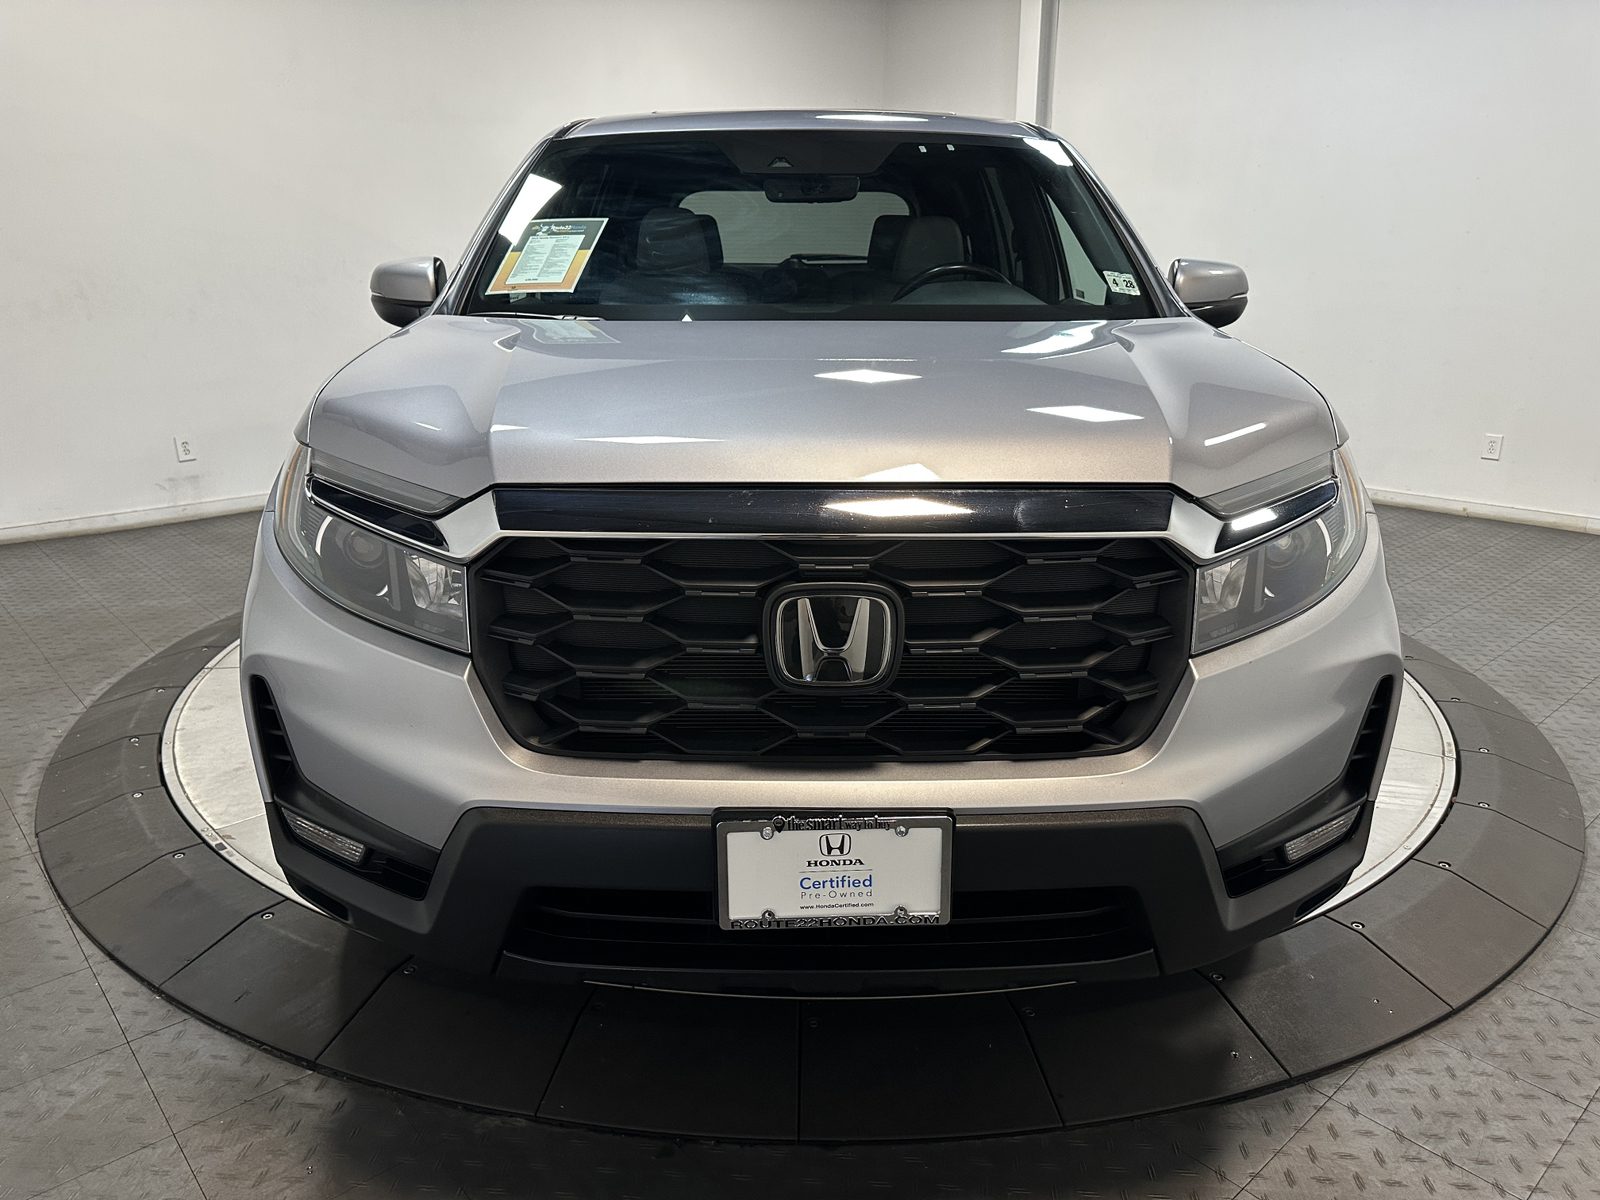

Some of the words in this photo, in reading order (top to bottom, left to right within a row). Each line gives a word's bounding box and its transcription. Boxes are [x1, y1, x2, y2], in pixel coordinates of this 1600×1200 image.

[1112, 278, 1118, 287] 4
[1122, 280, 1136, 288] 28
[806, 814, 843, 831] smart
[845, 819, 862, 832] way
[863, 817, 873, 830] to
[876, 815, 891, 832] buy
[806, 858, 865, 868] HONDA
[799, 874, 873, 890] Certified
[800, 889, 873, 899] Pre-Owned
[800, 901, 874, 911] www.HondaCertified.com
[730, 914, 940, 929] ROUTE22HONDA.COM
